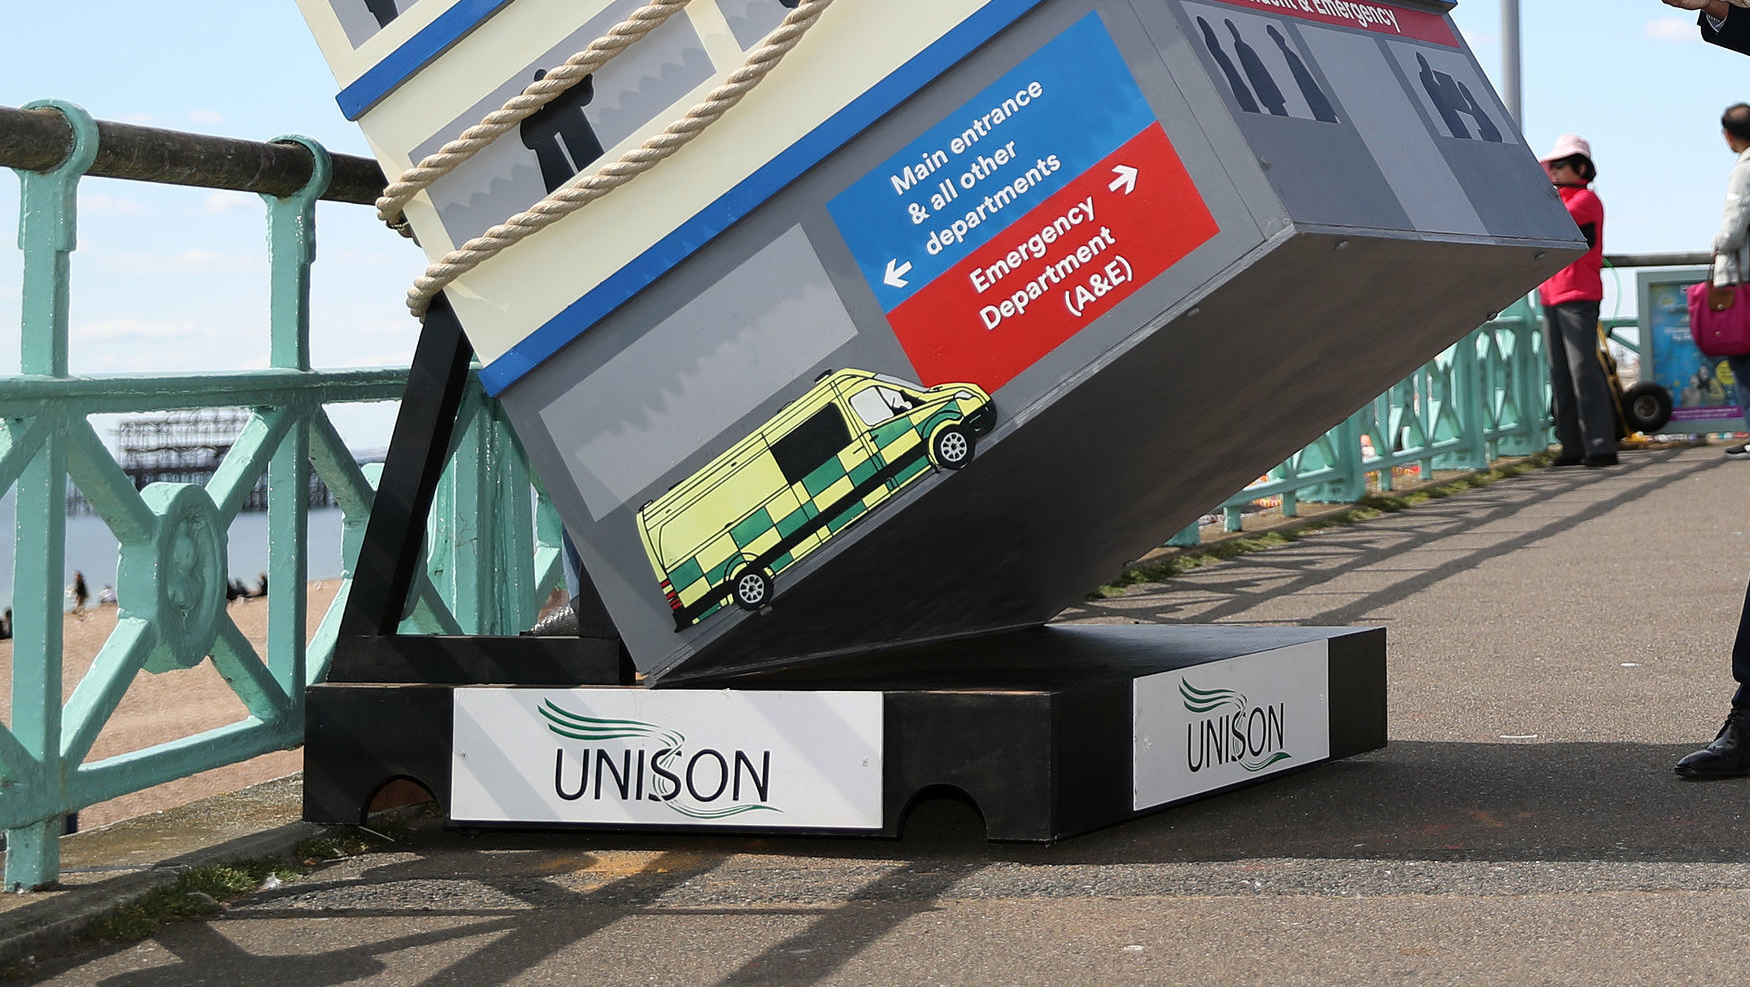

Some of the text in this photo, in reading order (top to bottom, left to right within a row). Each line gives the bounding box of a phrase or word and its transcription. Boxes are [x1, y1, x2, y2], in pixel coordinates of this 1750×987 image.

[890, 81, 1043, 196] Main entrance
[907, 140, 1016, 225] & all other
[926, 154, 1061, 255] departments
[969, 196, 1095, 294] Emergency
[979, 226, 1116, 331] Department
[1064, 255, 1133, 317] (A&E)
[555, 748, 771, 803] UNISON
[1187, 702, 1284, 772] UNISON
